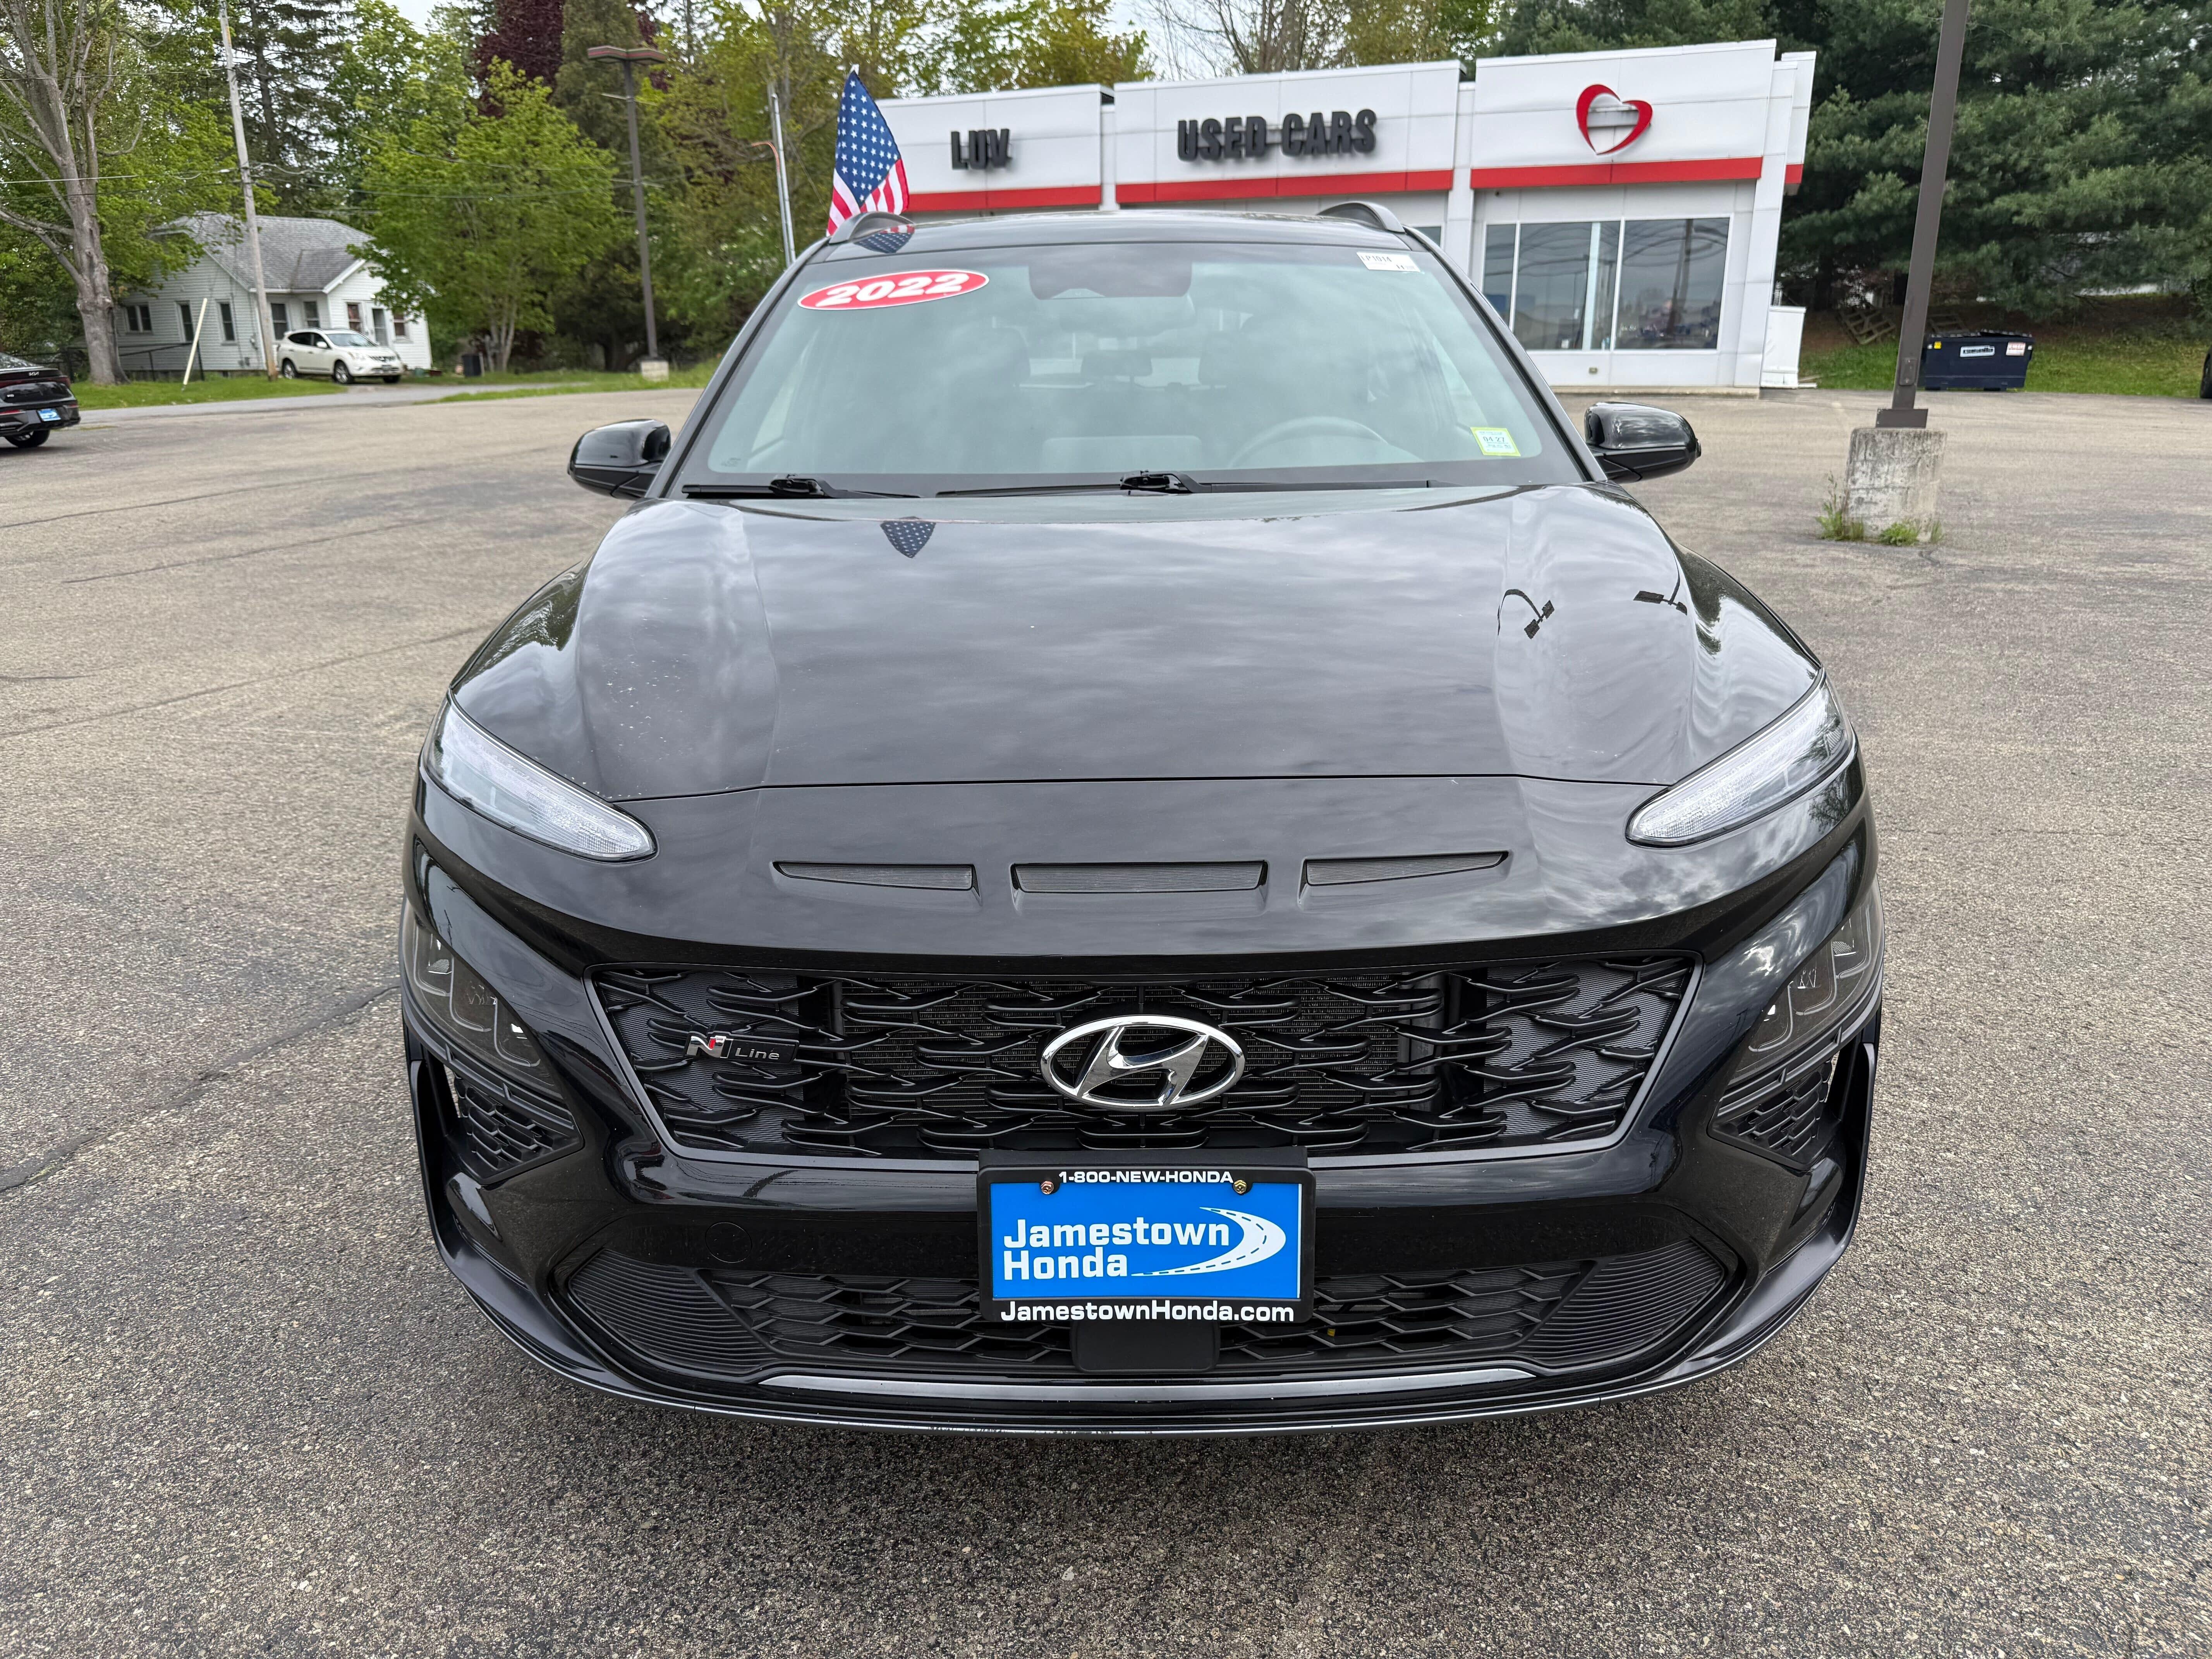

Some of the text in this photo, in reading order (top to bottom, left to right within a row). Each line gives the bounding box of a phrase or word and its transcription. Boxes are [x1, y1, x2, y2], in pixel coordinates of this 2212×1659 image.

[951, 129, 1010, 170] LUV
[1178, 109, 1377, 161] USED CARS
[815, 273, 969, 307] 2022
[735, 1047, 780, 1060] Line
[1058, 1171, 1234, 1183] 1-800-NEW-HONDA
[1004, 1217, 1230, 1248] Jamestown
[1004, 1247, 1128, 1280] Honda
[1001, 1300, 1295, 1322] JamestownHonda.com
